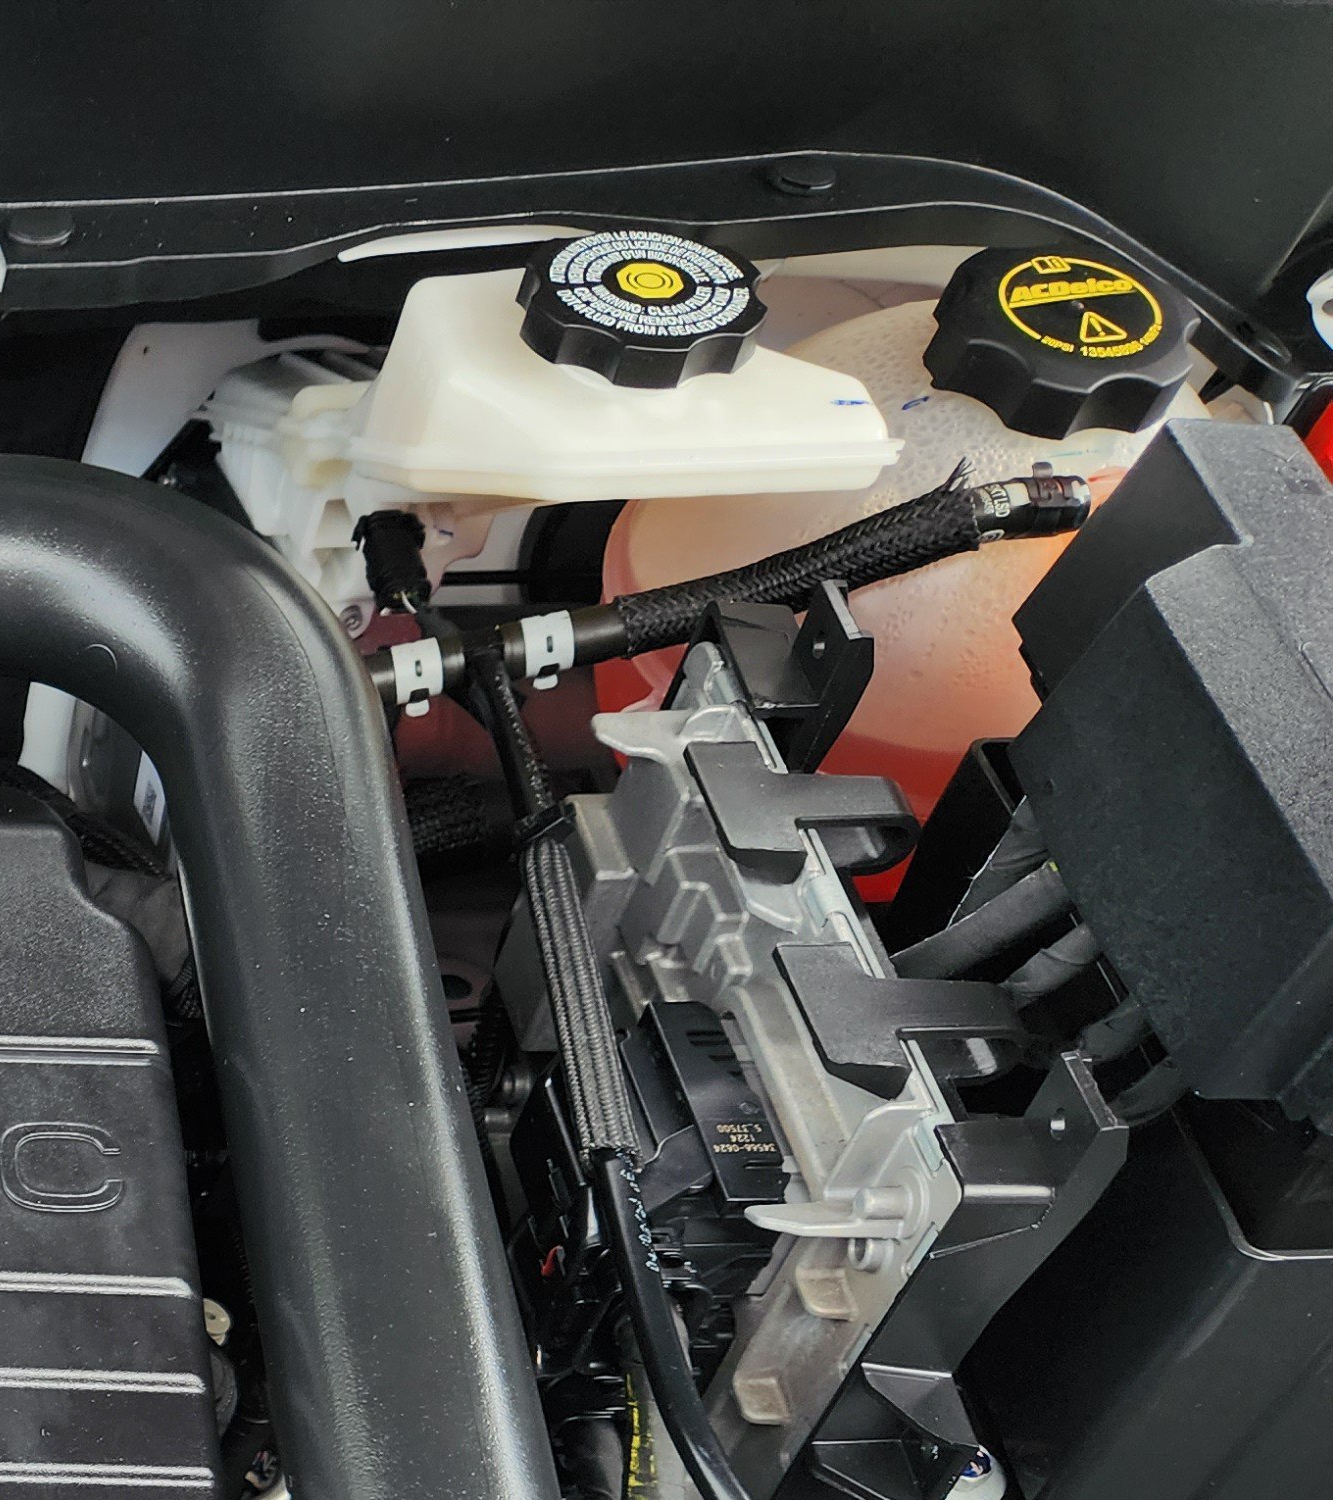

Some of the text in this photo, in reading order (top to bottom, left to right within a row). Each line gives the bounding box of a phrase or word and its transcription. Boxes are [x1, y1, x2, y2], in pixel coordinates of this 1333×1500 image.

[1009, 278, 1134, 303] ACDelco
[615, 320, 657, 336] FROM
[657, 325, 668, 336] A
